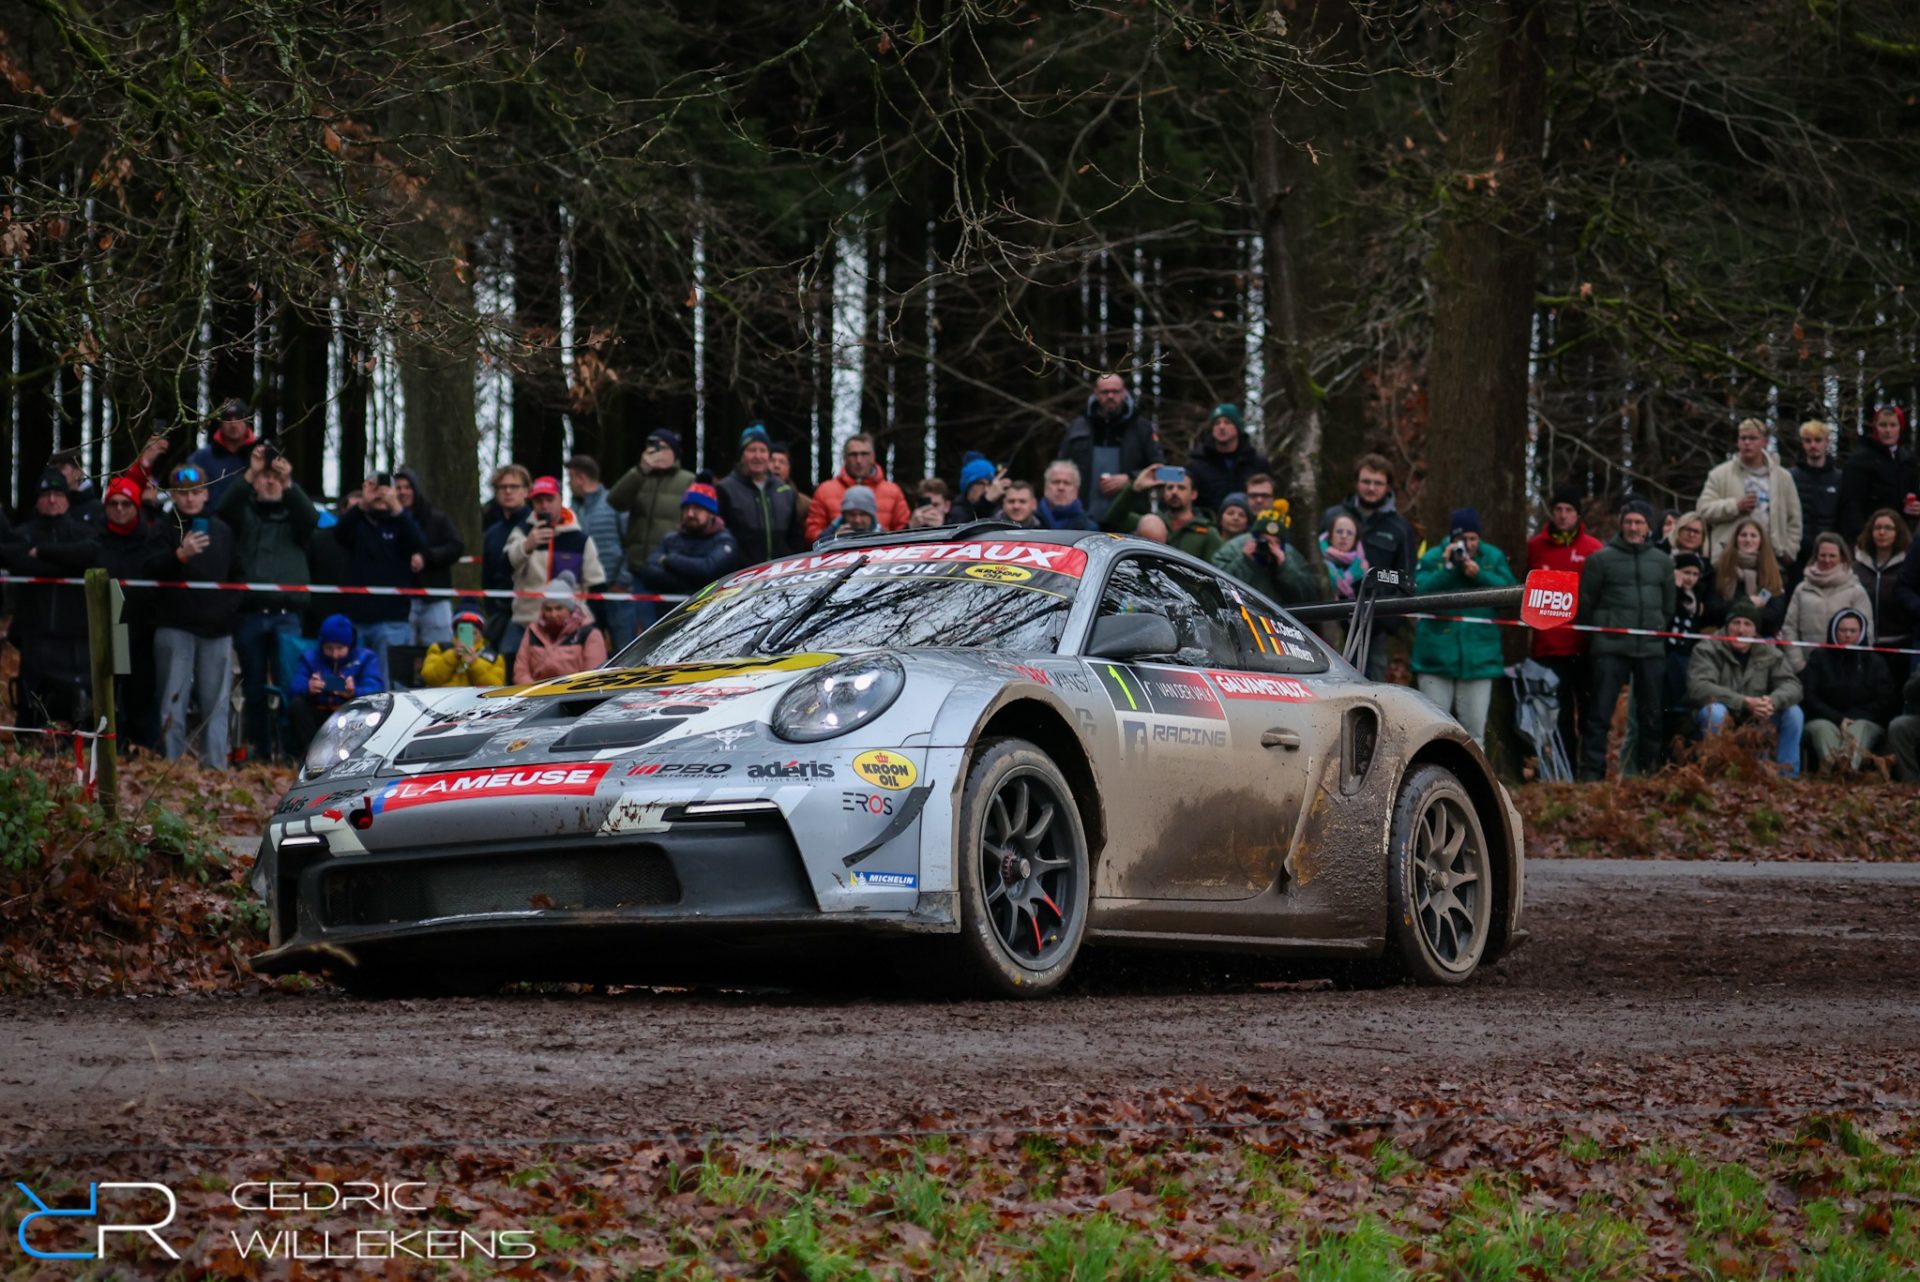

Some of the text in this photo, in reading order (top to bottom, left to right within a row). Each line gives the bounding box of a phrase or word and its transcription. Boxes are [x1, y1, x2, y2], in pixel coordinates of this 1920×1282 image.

[722, 543, 1064, 588] GALVAMETAUX
[975, 567, 1022, 578] KROON
[1540, 589, 1574, 611] PBO
[1539, 608, 1573, 619] MOTORSPORT
[1239, 605, 1266, 654] 1
[1052, 671, 1089, 694] VINS
[1106, 664, 1138, 711] 1
[1215, 674, 1313, 699] GALVAMETAUX
[1152, 723, 1227, 749] RACING
[656, 763, 732, 775] PBO
[747, 760, 835, 778] adéris
[861, 763, 910, 777] KROON
[878, 776, 900, 788] OIL
[842, 791, 894, 816] EROS
[868, 874, 914, 885] MICHELIN
